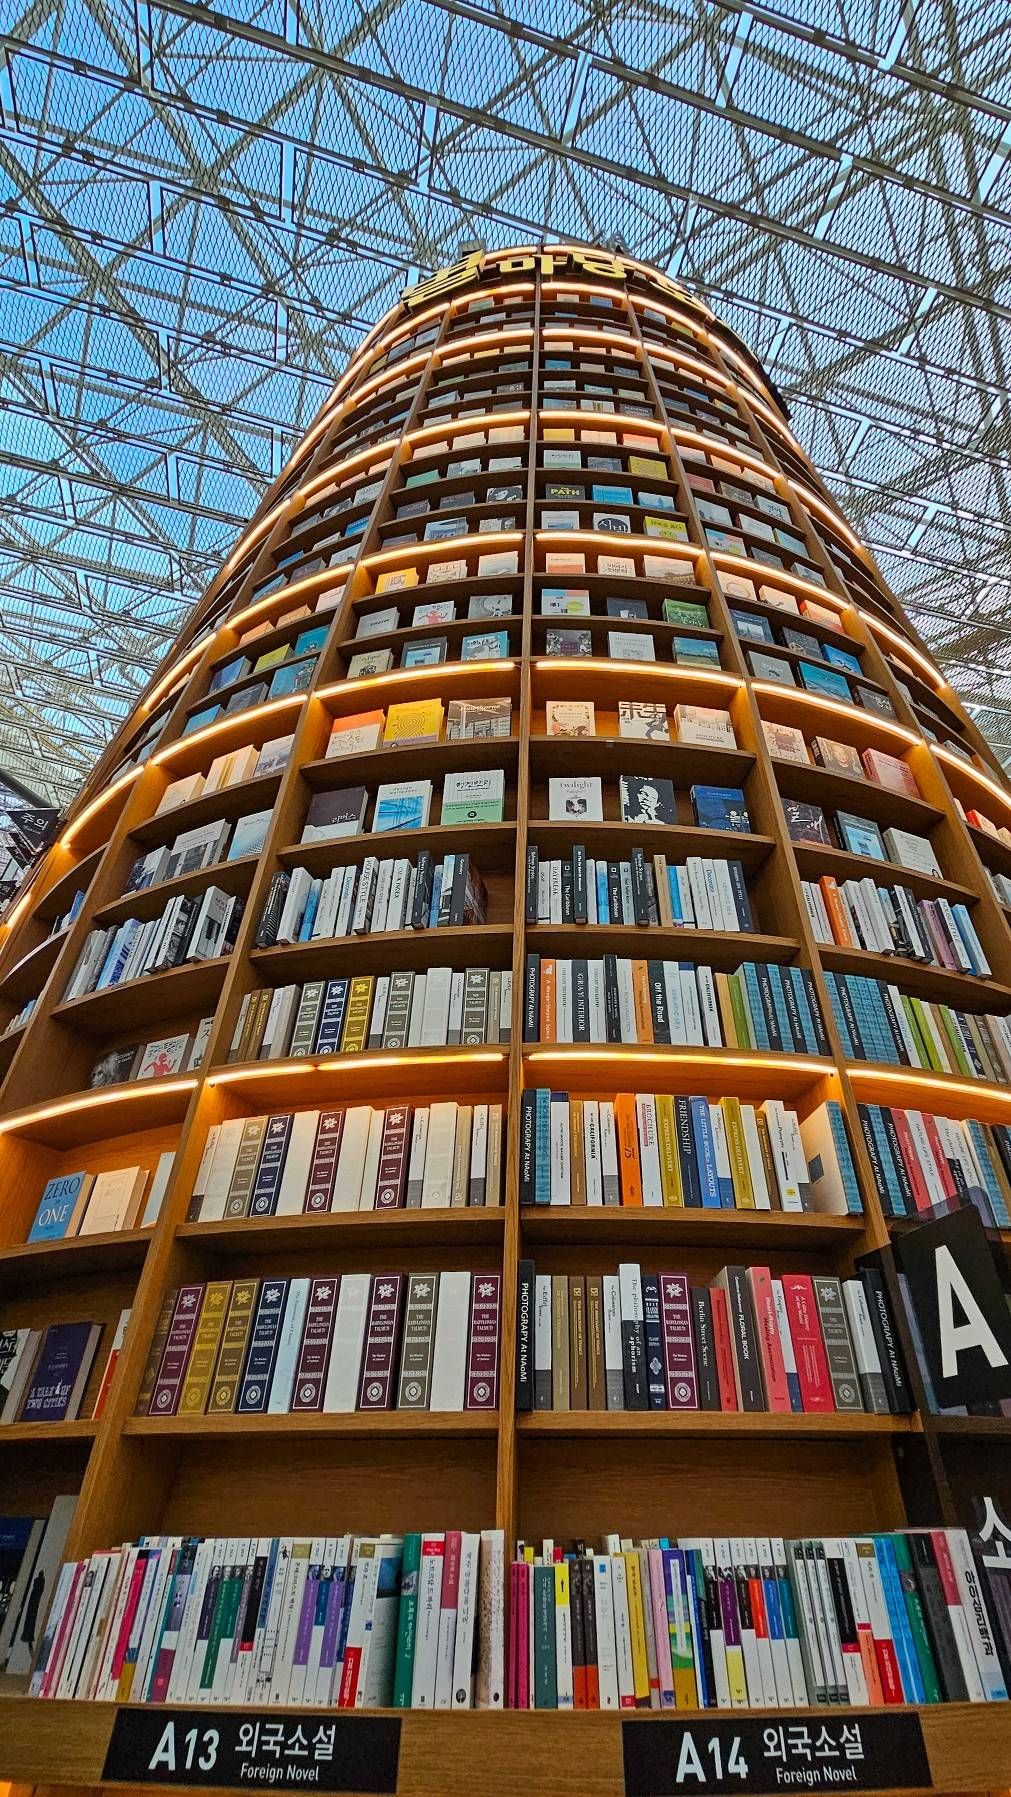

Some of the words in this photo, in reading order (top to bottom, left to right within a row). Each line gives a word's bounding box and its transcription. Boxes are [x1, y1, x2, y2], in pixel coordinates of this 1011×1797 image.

[560, 780, 592, 789] twilight
[678, 1100, 692, 1154] FRIENDSHIP
[624, 1147, 635, 1159] 75
[45, 1177, 80, 1200] ZERO
[705, 1164, 717, 1198] LAYOUTS
[38, 1205, 69, 1227] ONE
[520, 1283, 529, 1342] PHOTOGRAPY
[738, 1314, 747, 1338] FLORAL
[875, 1290, 895, 1347] PHOTOGRAPY
[935, 1245, 1009, 1378] A
[741, 1340, 750, 1359] BOOK
[148, 1720, 220, 1771] A13
[235, 1722, 337, 1761] 외국소설
[675, 1731, 749, 1783] A14
[763, 1722, 865, 1761] 외국소설
[240, 1762, 283, 1782] Foreign
[286, 1764, 320, 1782] Novel
[776, 1767, 821, 1784] Foreign
[824, 1766, 857, 1782] Novel
